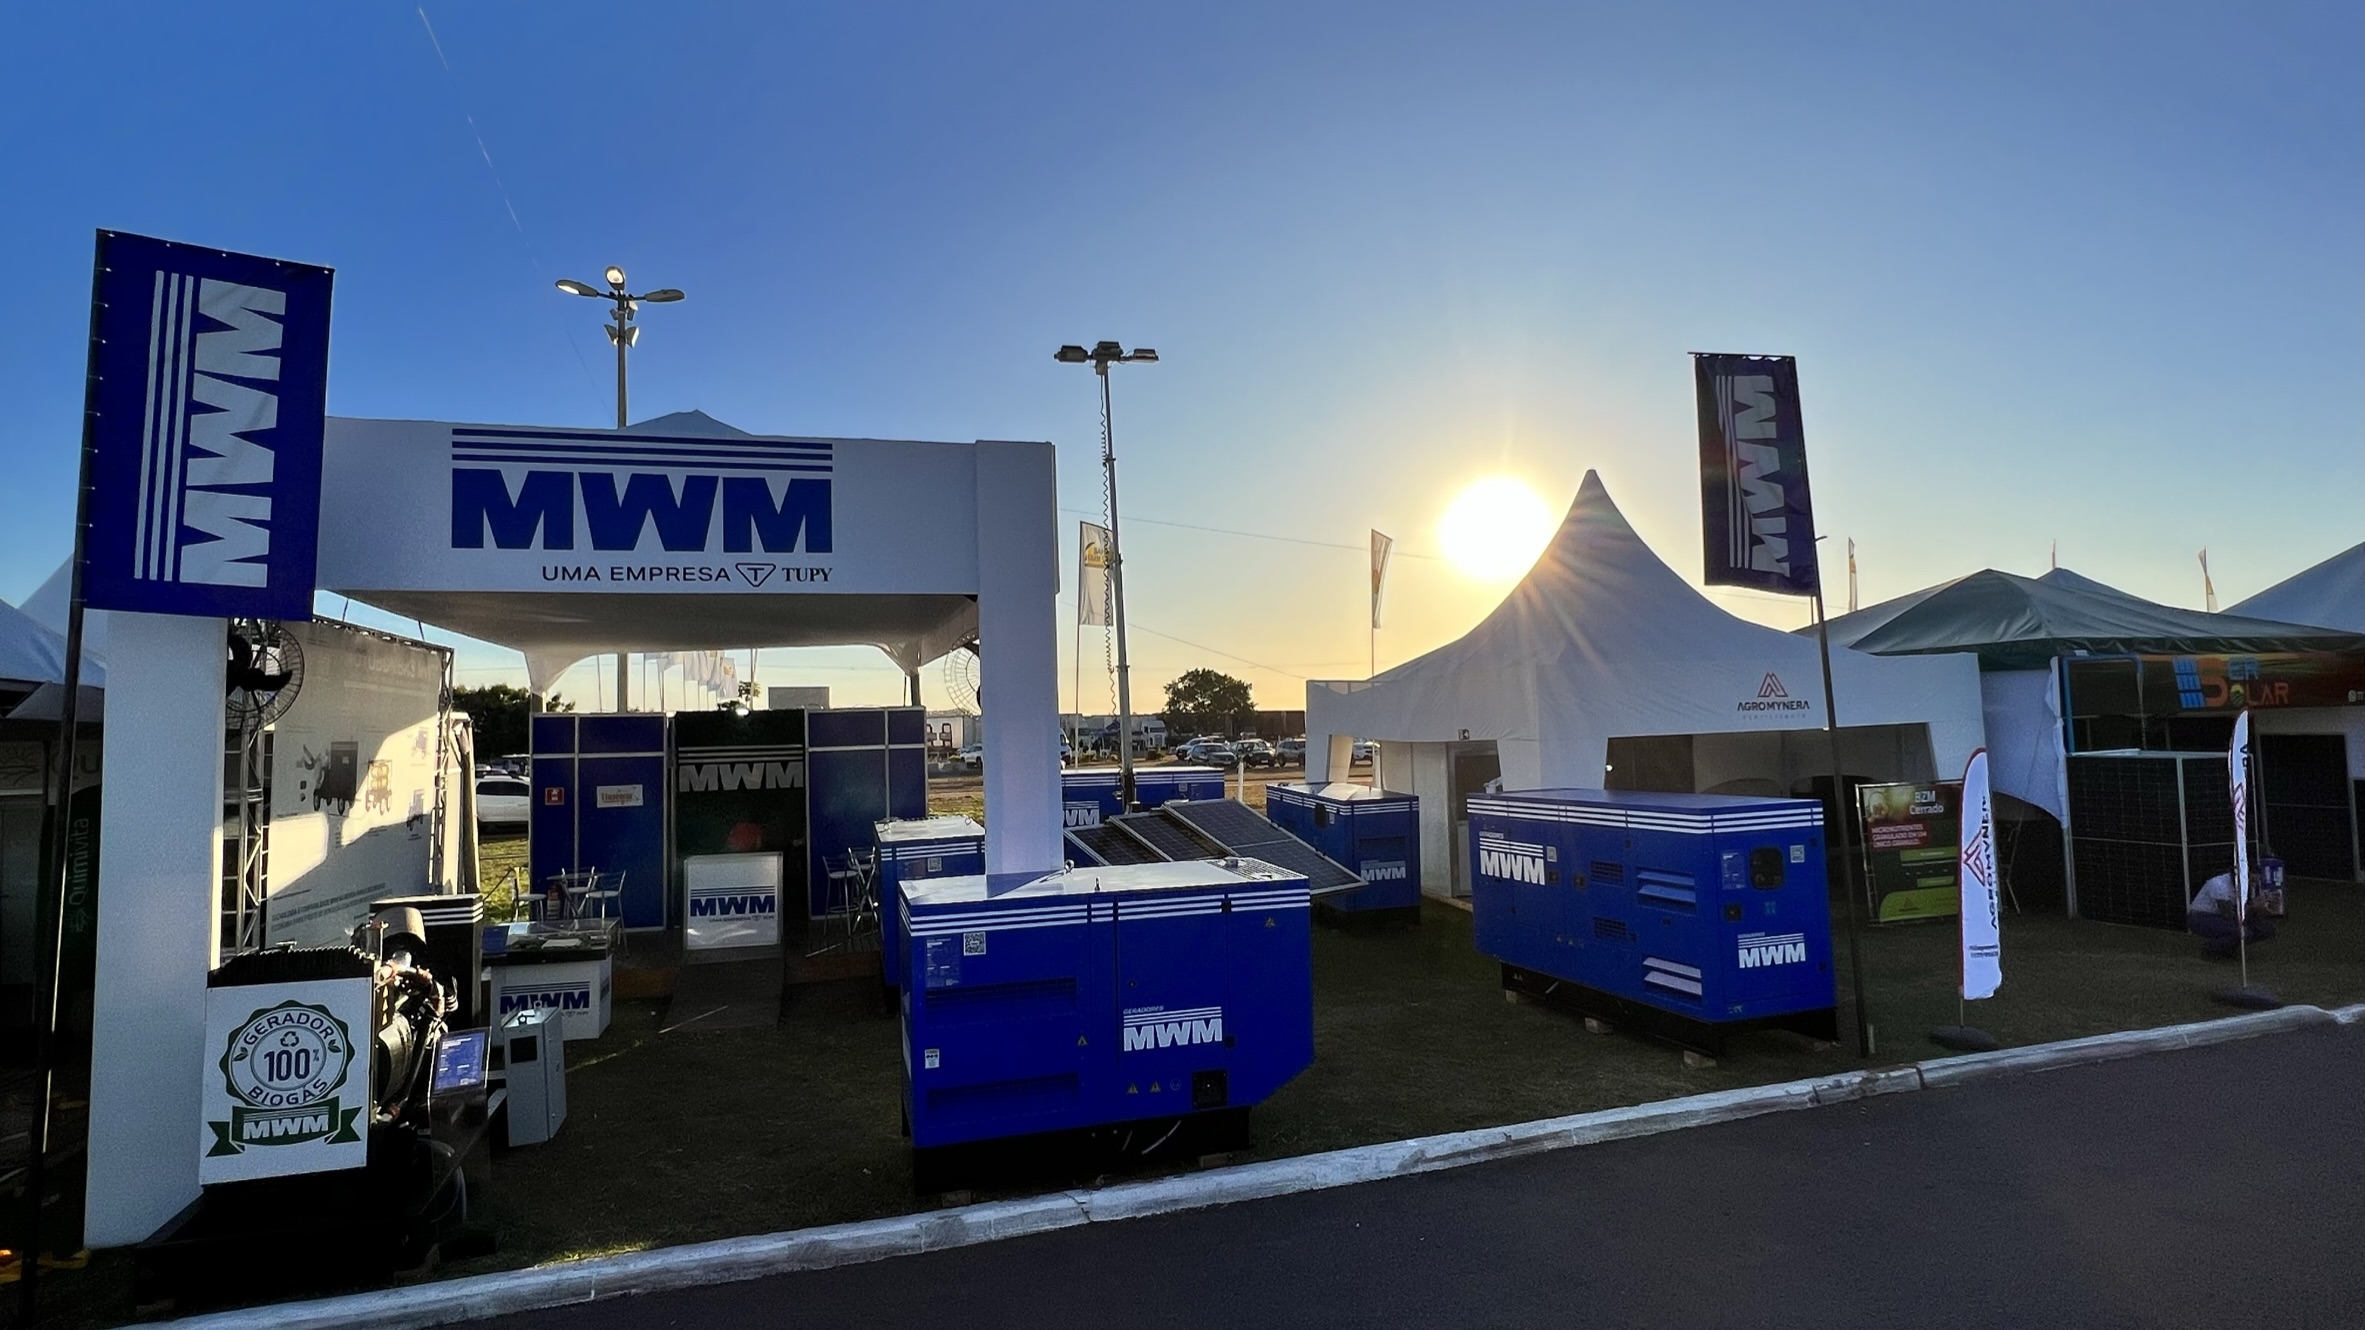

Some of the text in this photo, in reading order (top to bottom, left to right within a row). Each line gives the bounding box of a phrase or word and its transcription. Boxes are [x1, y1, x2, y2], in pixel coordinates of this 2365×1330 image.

[179, 277, 286, 588] MWM
[1733, 375, 1791, 578] MWM
[451, 468, 833, 553] MWM
[542, 566, 601, 582] UMA
[609, 566, 731, 582] EMPRESA
[781, 567, 833, 583] TUPY
[1737, 700, 1810, 712] AGROMYNERA
[678, 761, 804, 793] MWM
[1909, 803, 1944, 815] Cerrado
[68, 817, 89, 906] Quimivita
[1360, 866, 1406, 881] MWM
[1479, 849, 1545, 886] MWM
[690, 895, 775, 917] MWM
[1737, 942, 1806, 969] MWM
[500, 991, 590, 1015] MWM
[1123, 1005, 1165, 1015] GERADORES
[243, 1012, 335, 1046] GERADOR
[1123, 1018, 1223, 1052] MWM
[248, 1078, 328, 1106] BIOGAS
[243, 1114, 329, 1140] MWM
